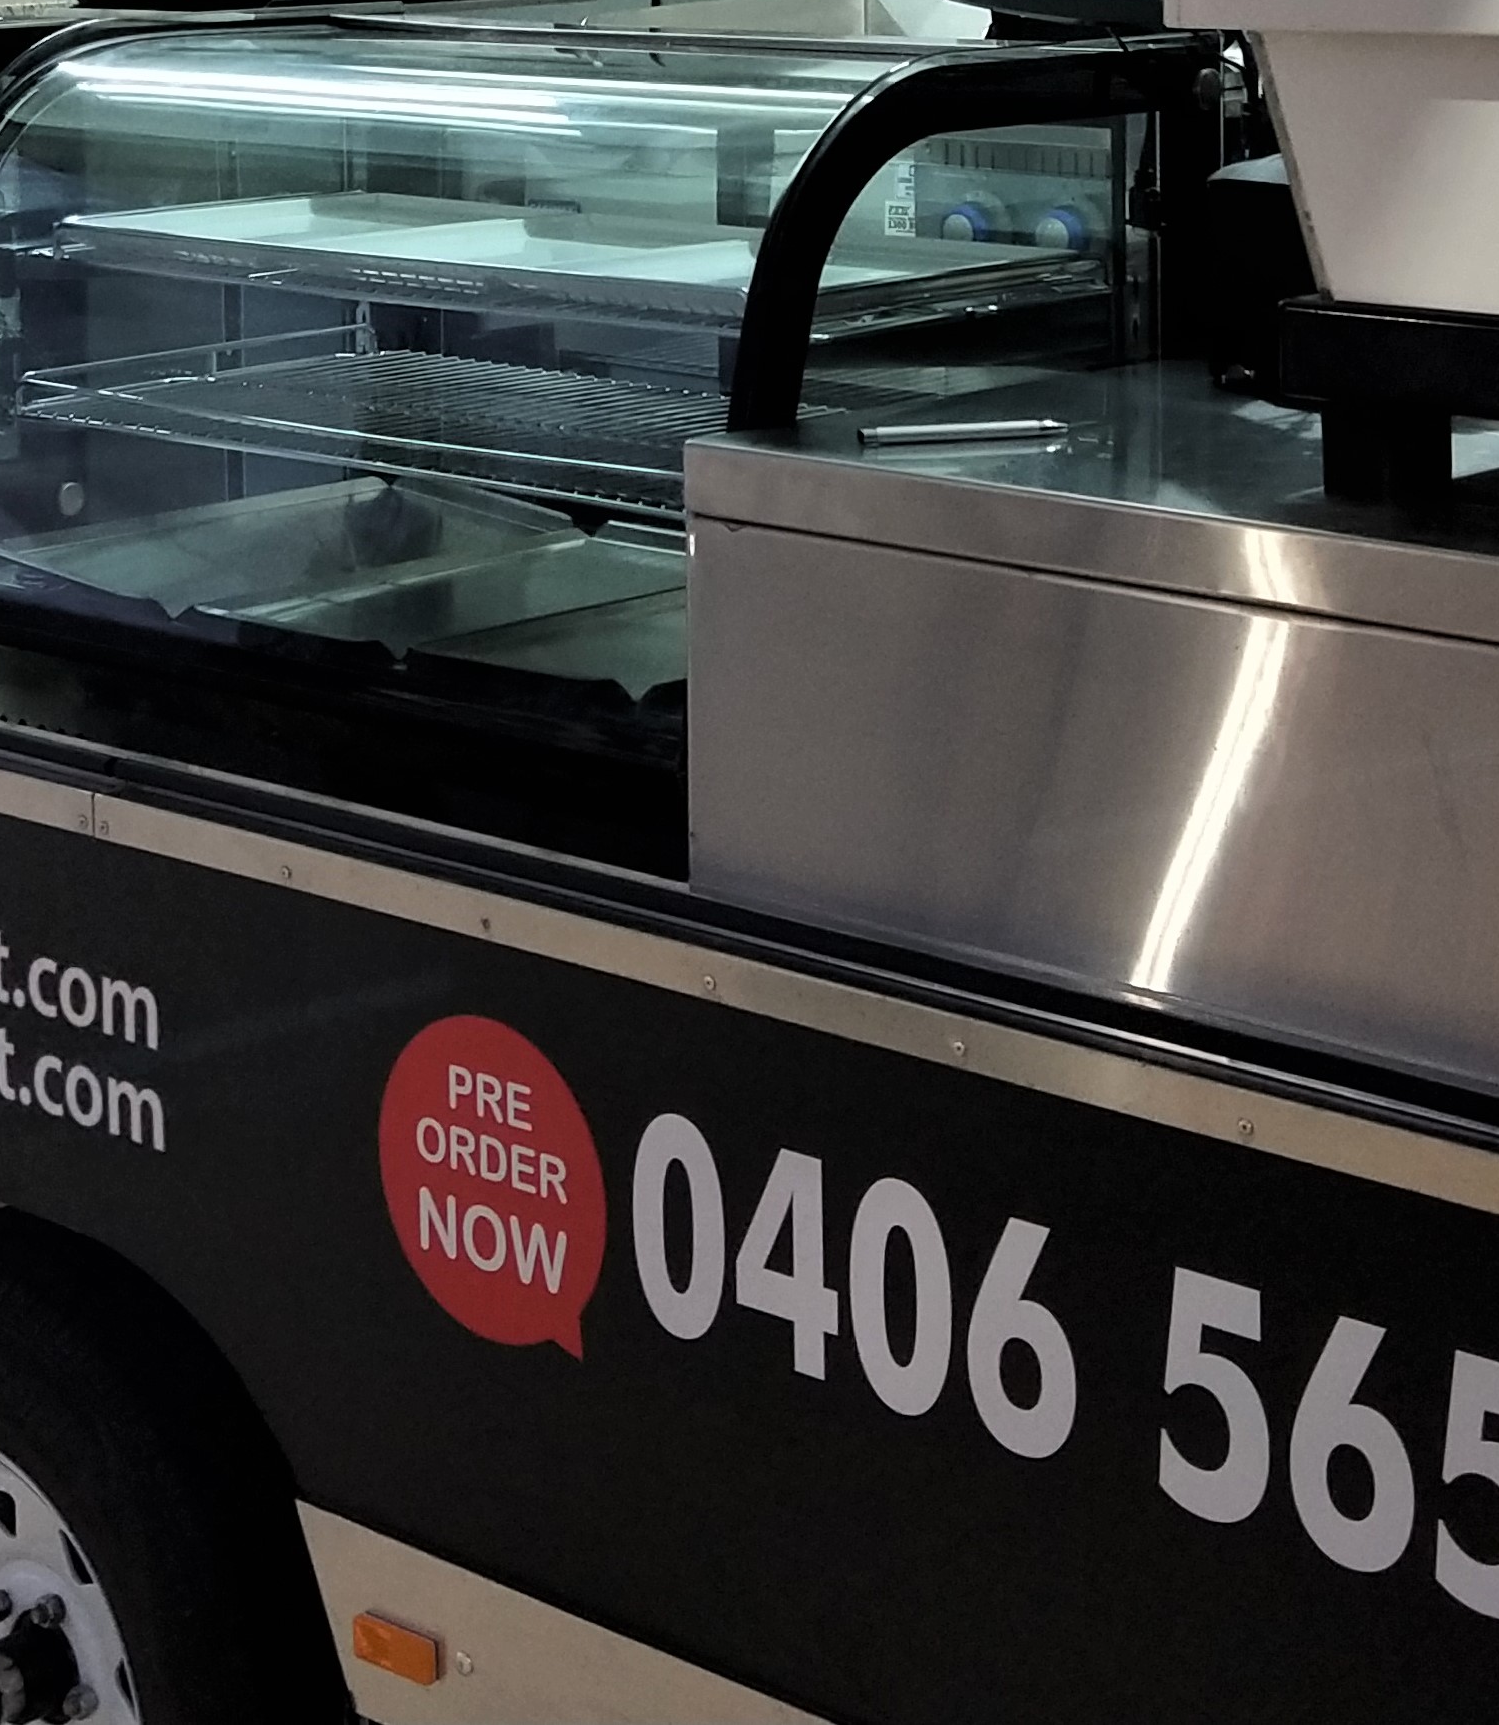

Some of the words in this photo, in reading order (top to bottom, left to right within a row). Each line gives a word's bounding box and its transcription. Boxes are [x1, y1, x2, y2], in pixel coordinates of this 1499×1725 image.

[448, 1064, 533, 1132] PRE
[416, 1117, 568, 1205] ORDER
[418, 1186, 567, 1294] NOW
[632, 1113, 1077, 1459] 0406
